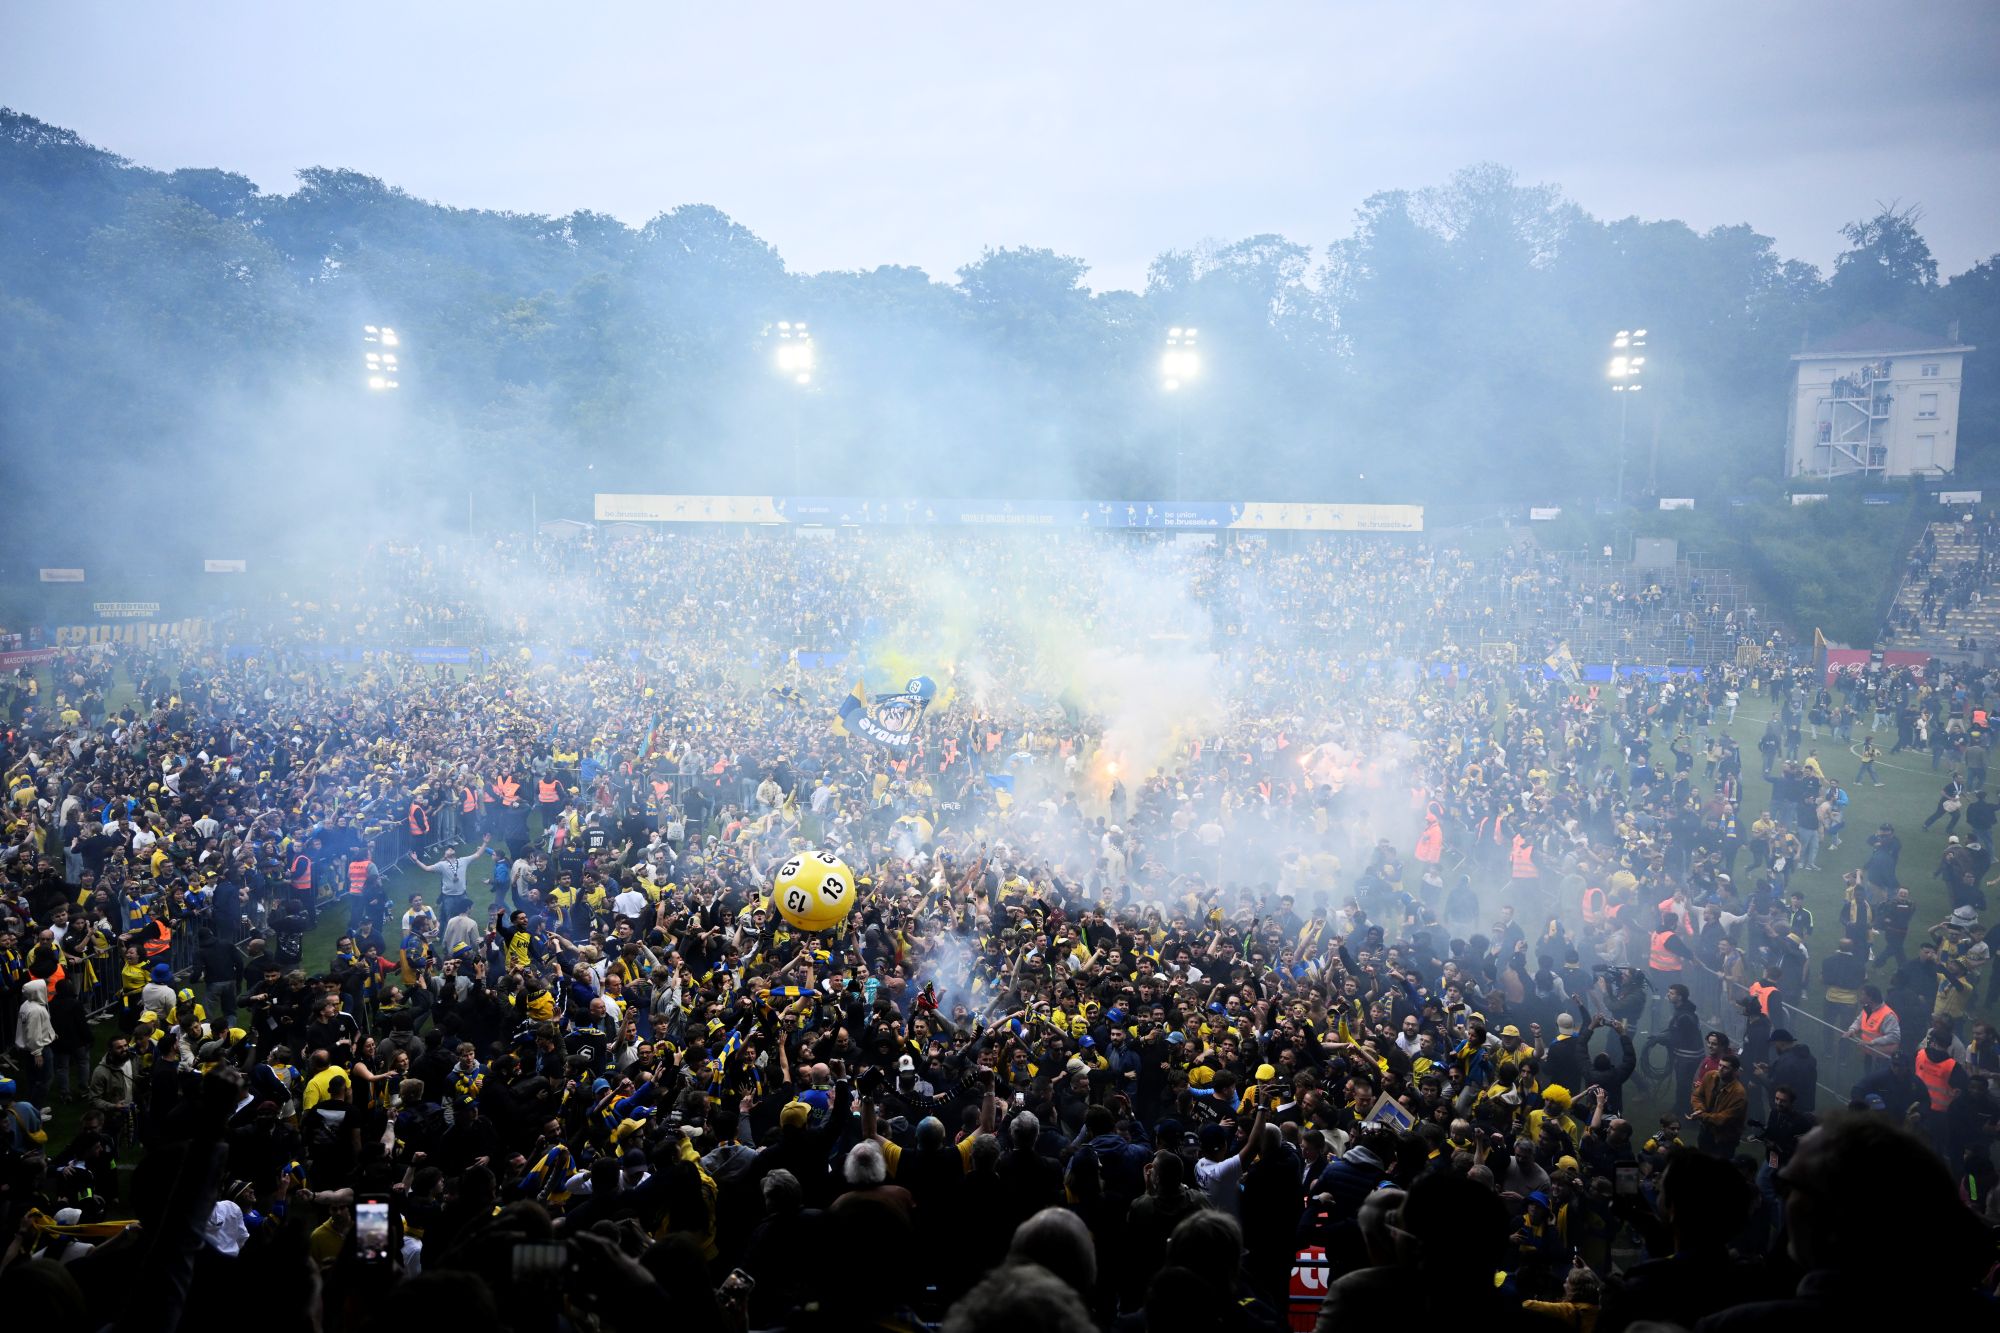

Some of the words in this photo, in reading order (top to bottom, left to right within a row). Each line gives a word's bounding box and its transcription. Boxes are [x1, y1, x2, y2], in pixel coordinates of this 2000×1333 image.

[1164, 518, 1208, 526] be.brussels
[590, 836, 603, 847] 1897
[781, 860, 800, 877] 13
[822, 877, 844, 900] 13
[787, 890, 806, 913] 13
